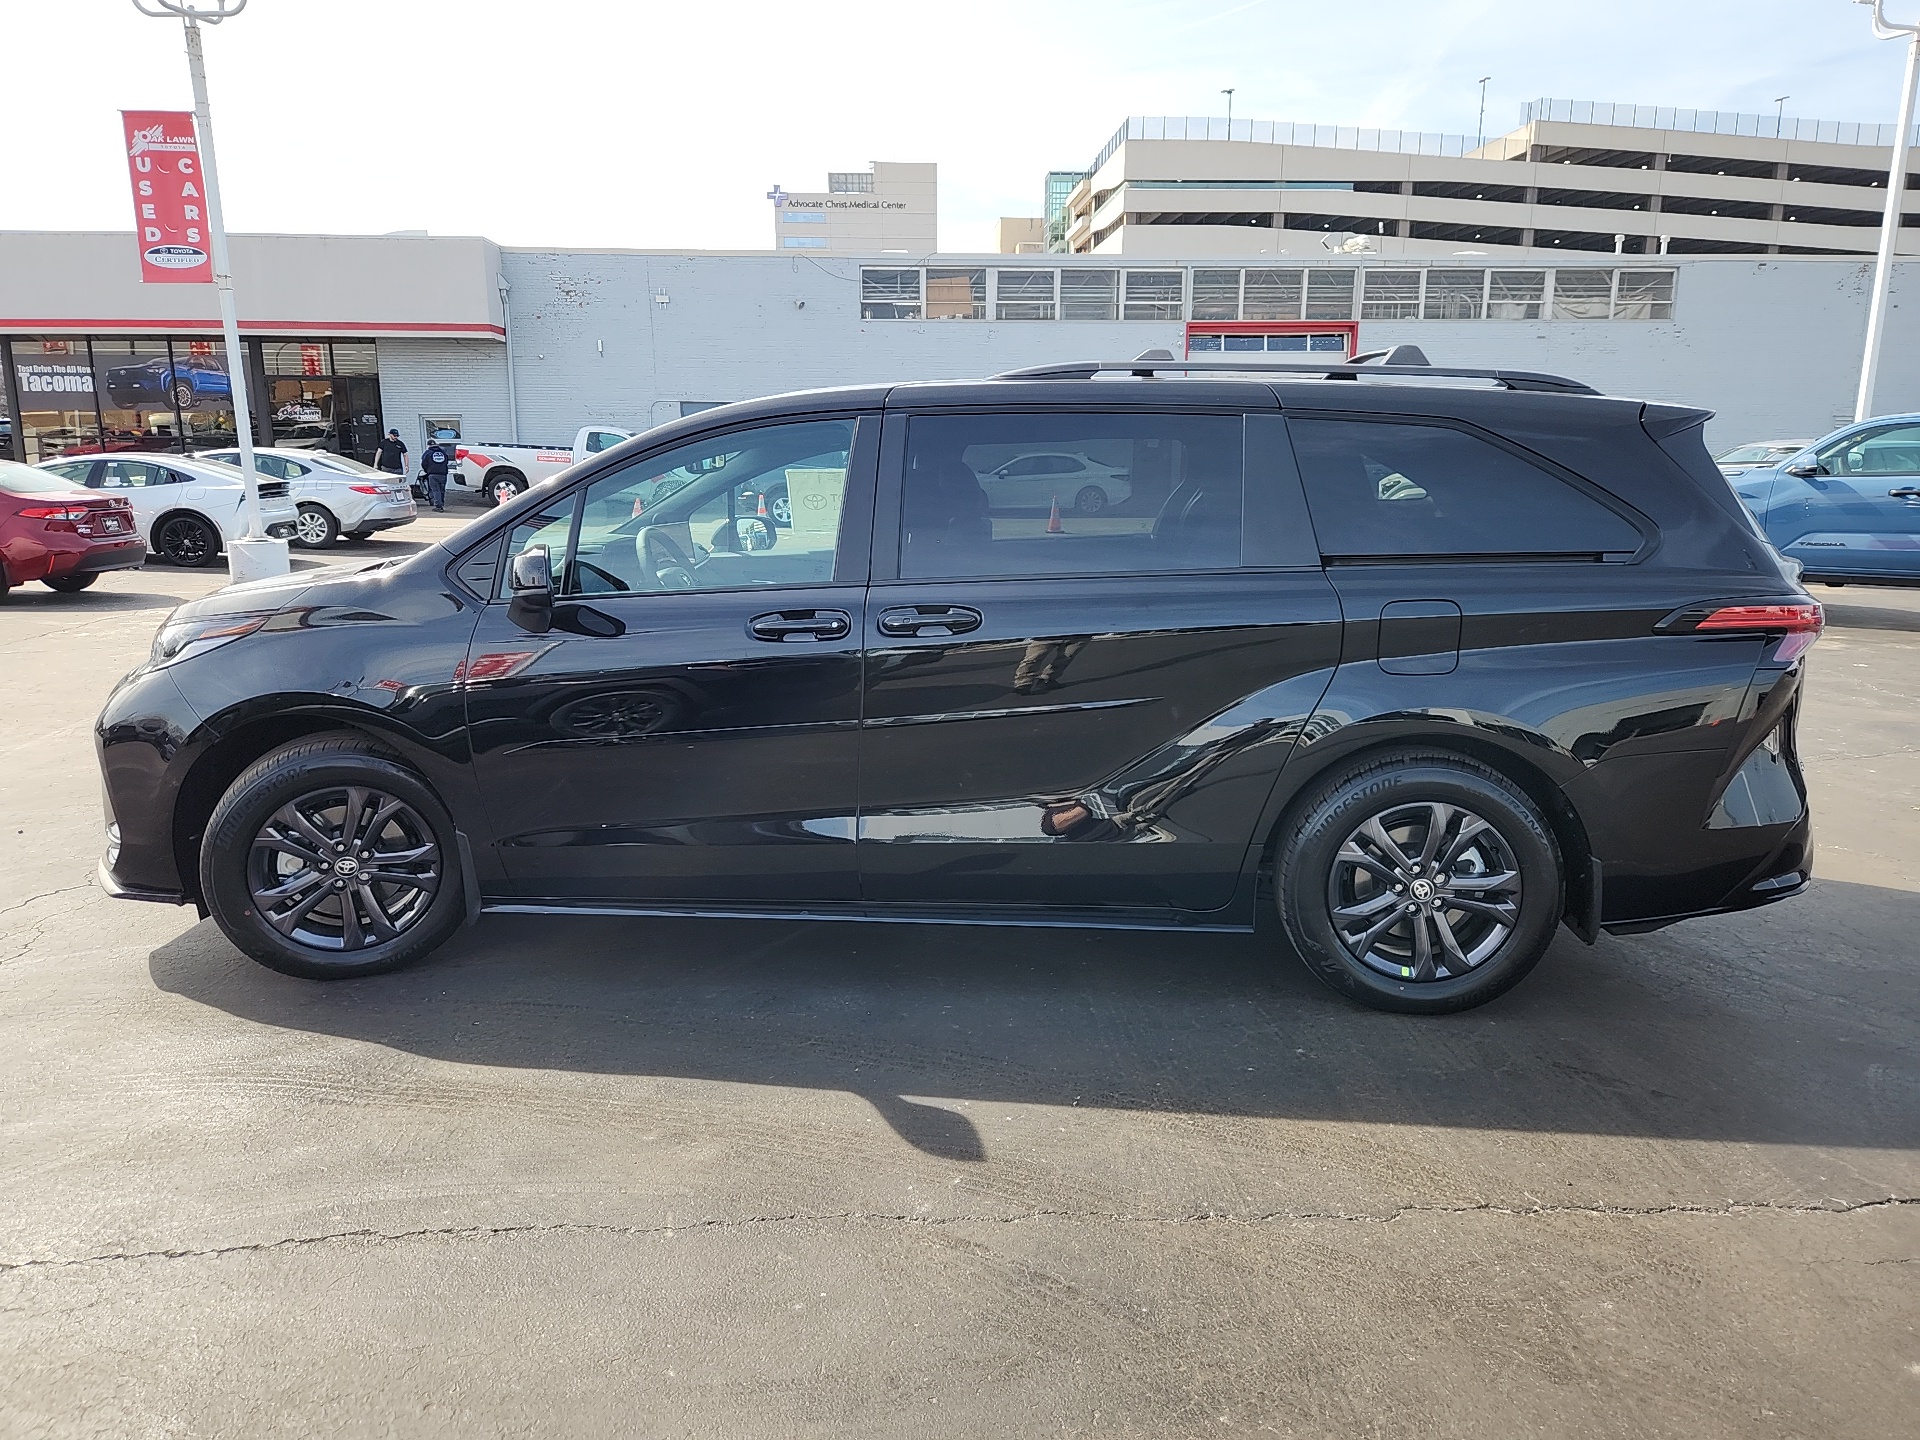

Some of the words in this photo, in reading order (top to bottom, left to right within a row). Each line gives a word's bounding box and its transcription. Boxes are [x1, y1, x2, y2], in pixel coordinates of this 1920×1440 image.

[138, 130, 165, 143] OAK
[166, 135, 195, 143] LAWN
[135, 156, 162, 243] USED
[177, 157, 201, 243] CARS
[787, 199, 824, 208] Advocate
[825, 199, 848, 209] Christ
[849, 200, 880, 209] Medical
[881, 200, 907, 209] Center
[17, 364, 33, 373] Test
[33, 364, 52, 373] Drive
[52, 365, 66, 373] The
[66, 365, 77, 373] All
[18, 372, 98, 392] Tacoma
[1309, 775, 1403, 842] RIDGESTONE
